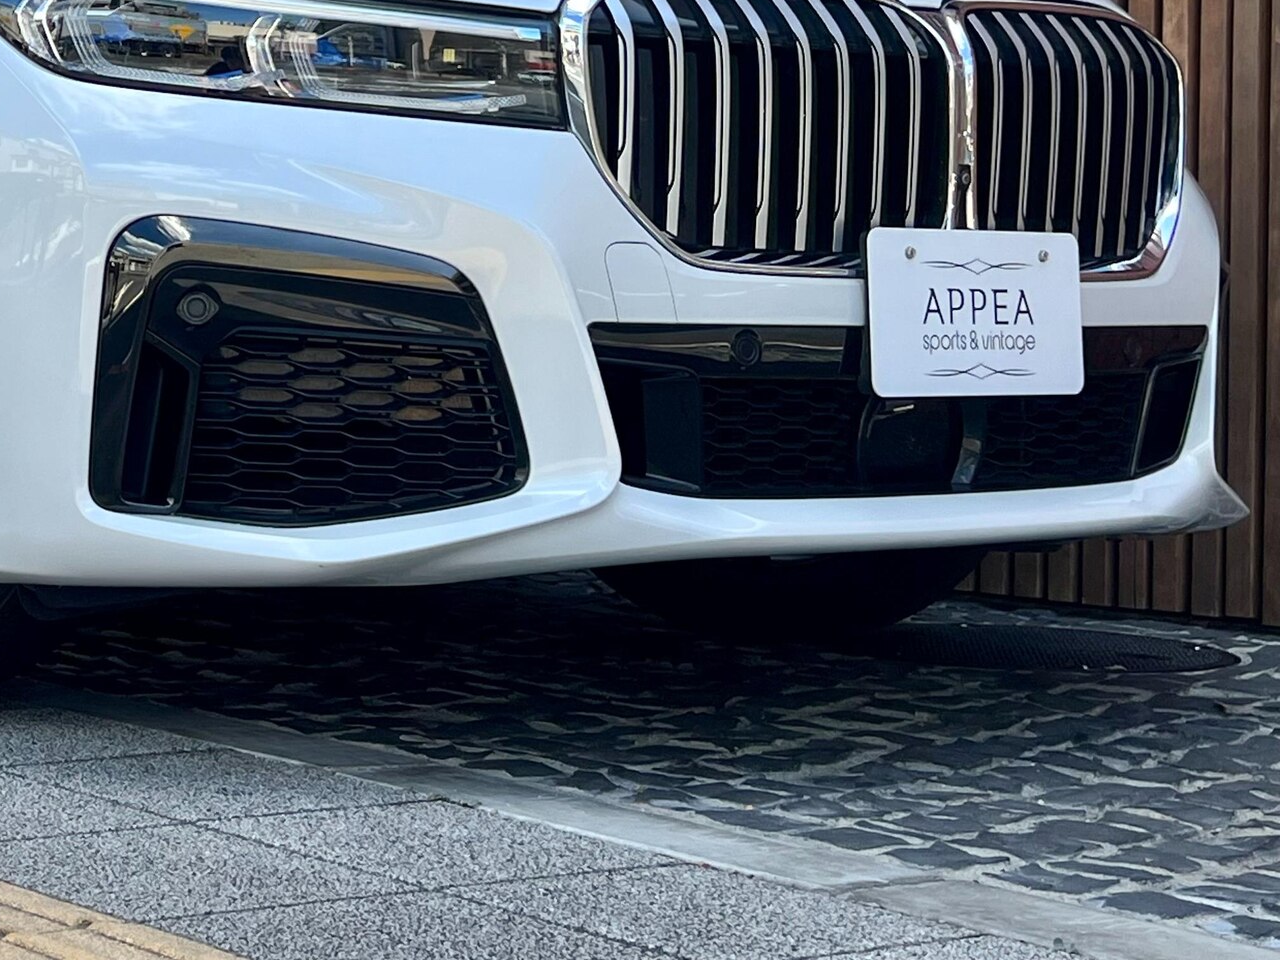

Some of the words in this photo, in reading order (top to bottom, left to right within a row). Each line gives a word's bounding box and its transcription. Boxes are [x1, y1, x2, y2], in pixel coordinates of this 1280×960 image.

[923, 288, 1034, 325] APPEA
[923, 330, 967, 355] sports
[969, 330, 979, 350] &
[981, 331, 1035, 355] vintage
